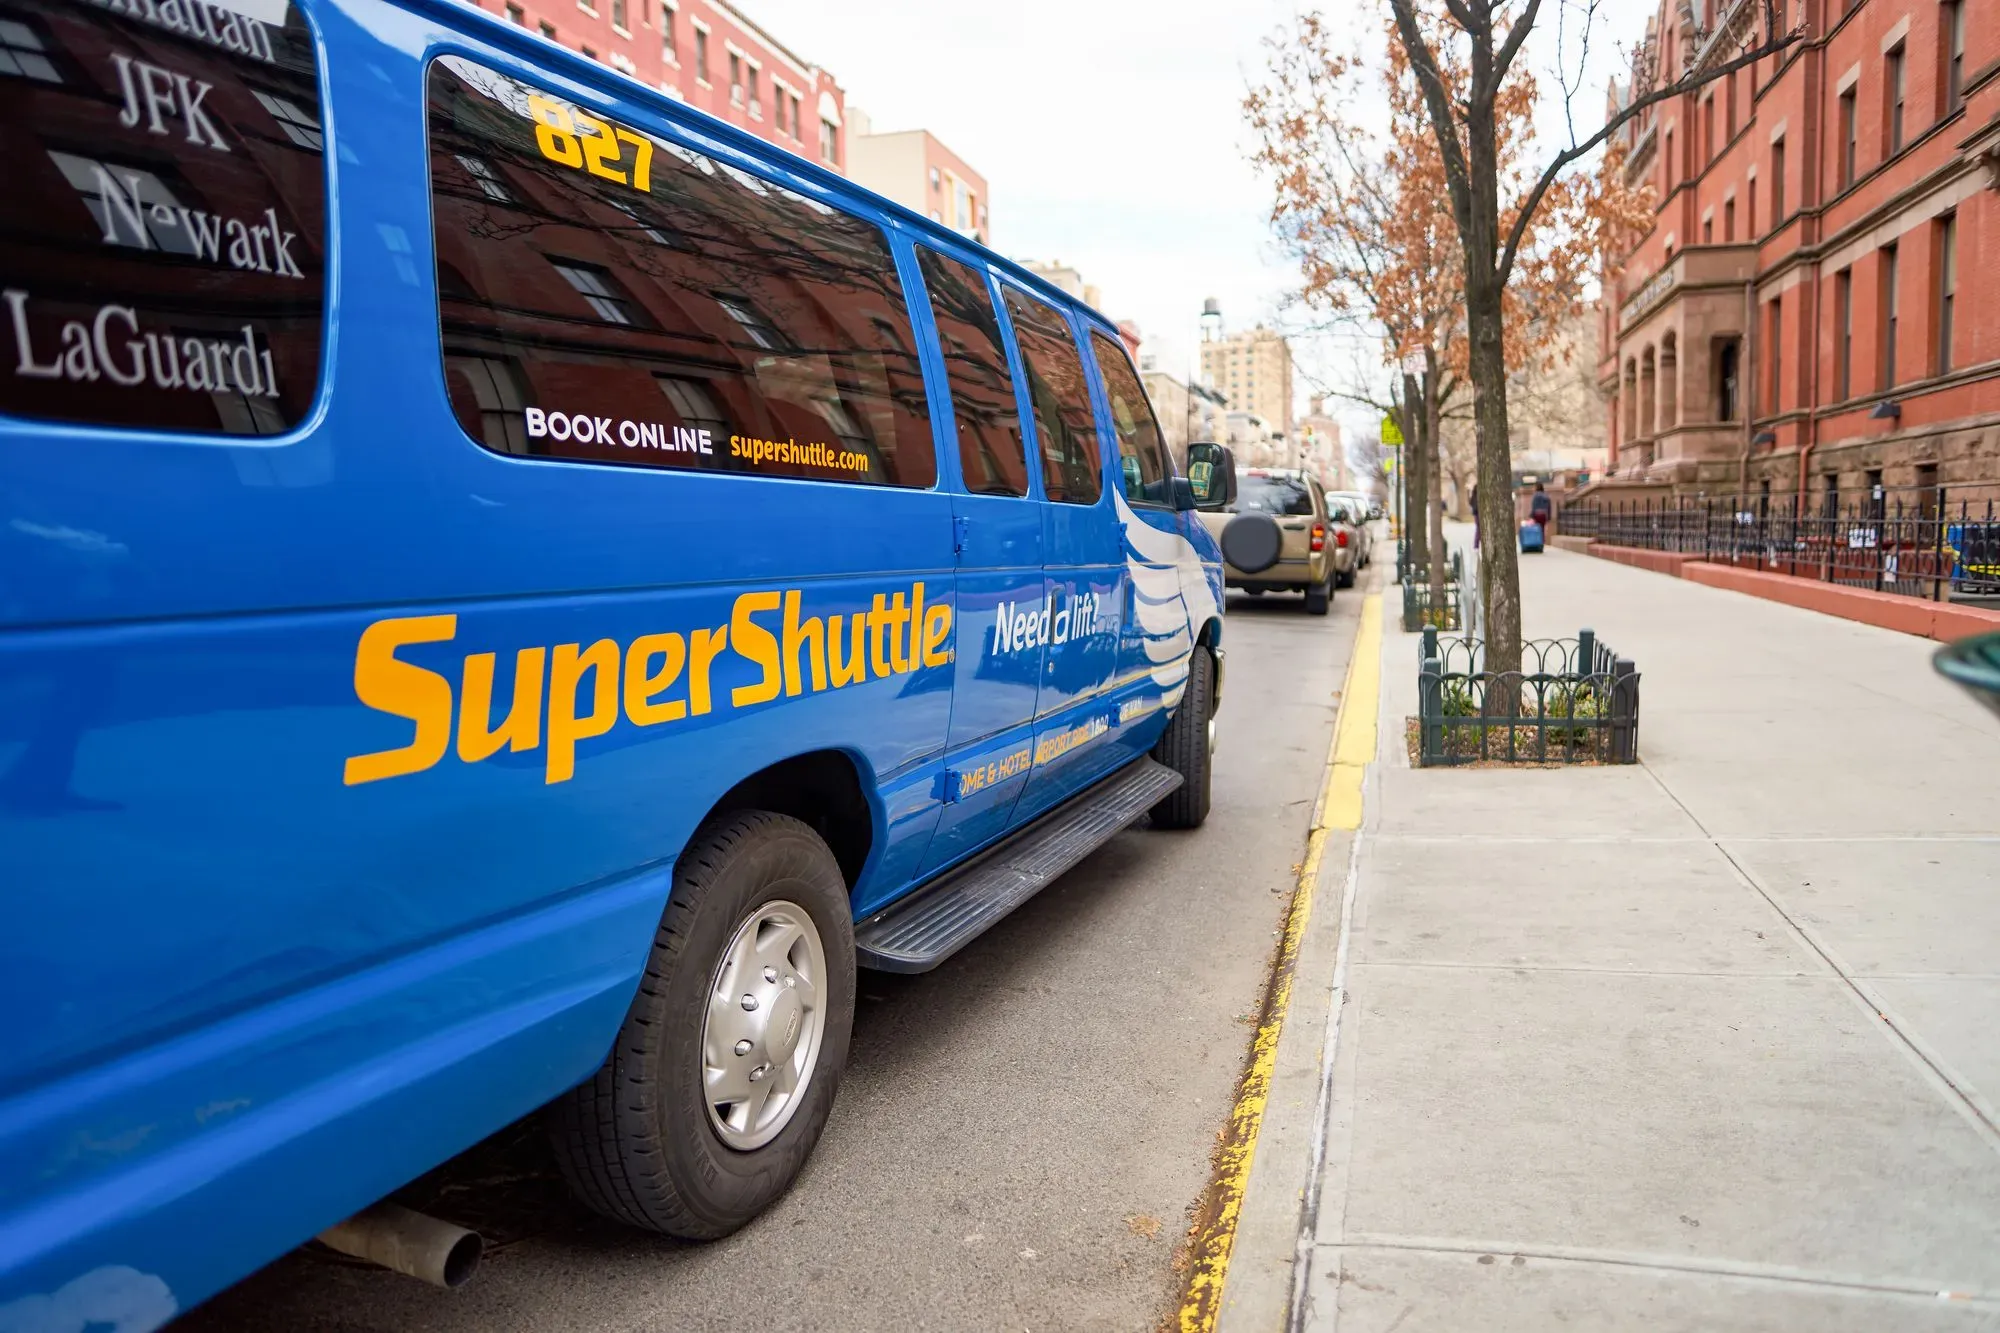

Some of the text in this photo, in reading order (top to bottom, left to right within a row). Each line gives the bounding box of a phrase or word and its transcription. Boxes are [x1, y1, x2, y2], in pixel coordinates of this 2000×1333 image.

[109, 52, 231, 152] JFK
[528, 94, 653, 193] 827
[525, 407, 713, 455] BOOK ONLINE
[730, 434, 869, 472] supershuttle.com
[992, 592, 1100, 656] Need a lift?
[343, 582, 952, 786] SuperShuttle
[959, 766, 986, 796] OME
[999, 748, 1032, 779] HOTEL
